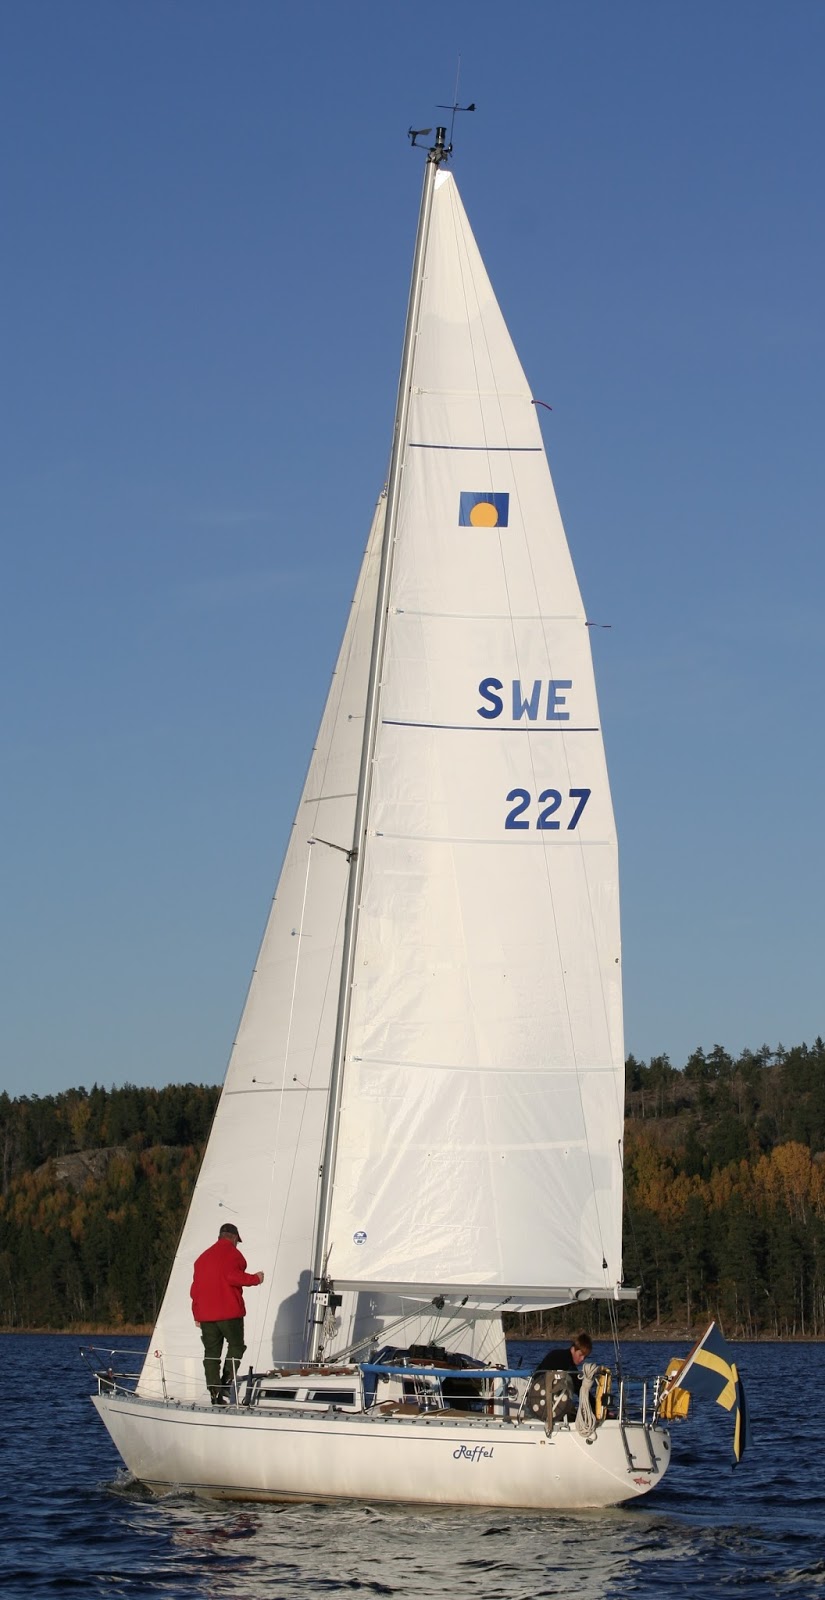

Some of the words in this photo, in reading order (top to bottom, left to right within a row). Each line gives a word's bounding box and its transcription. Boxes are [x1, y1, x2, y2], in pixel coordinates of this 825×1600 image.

[476, 677, 573, 721] SWE
[504, 788, 592, 830] 227
[453, 1445, 494, 1462] Raffel
